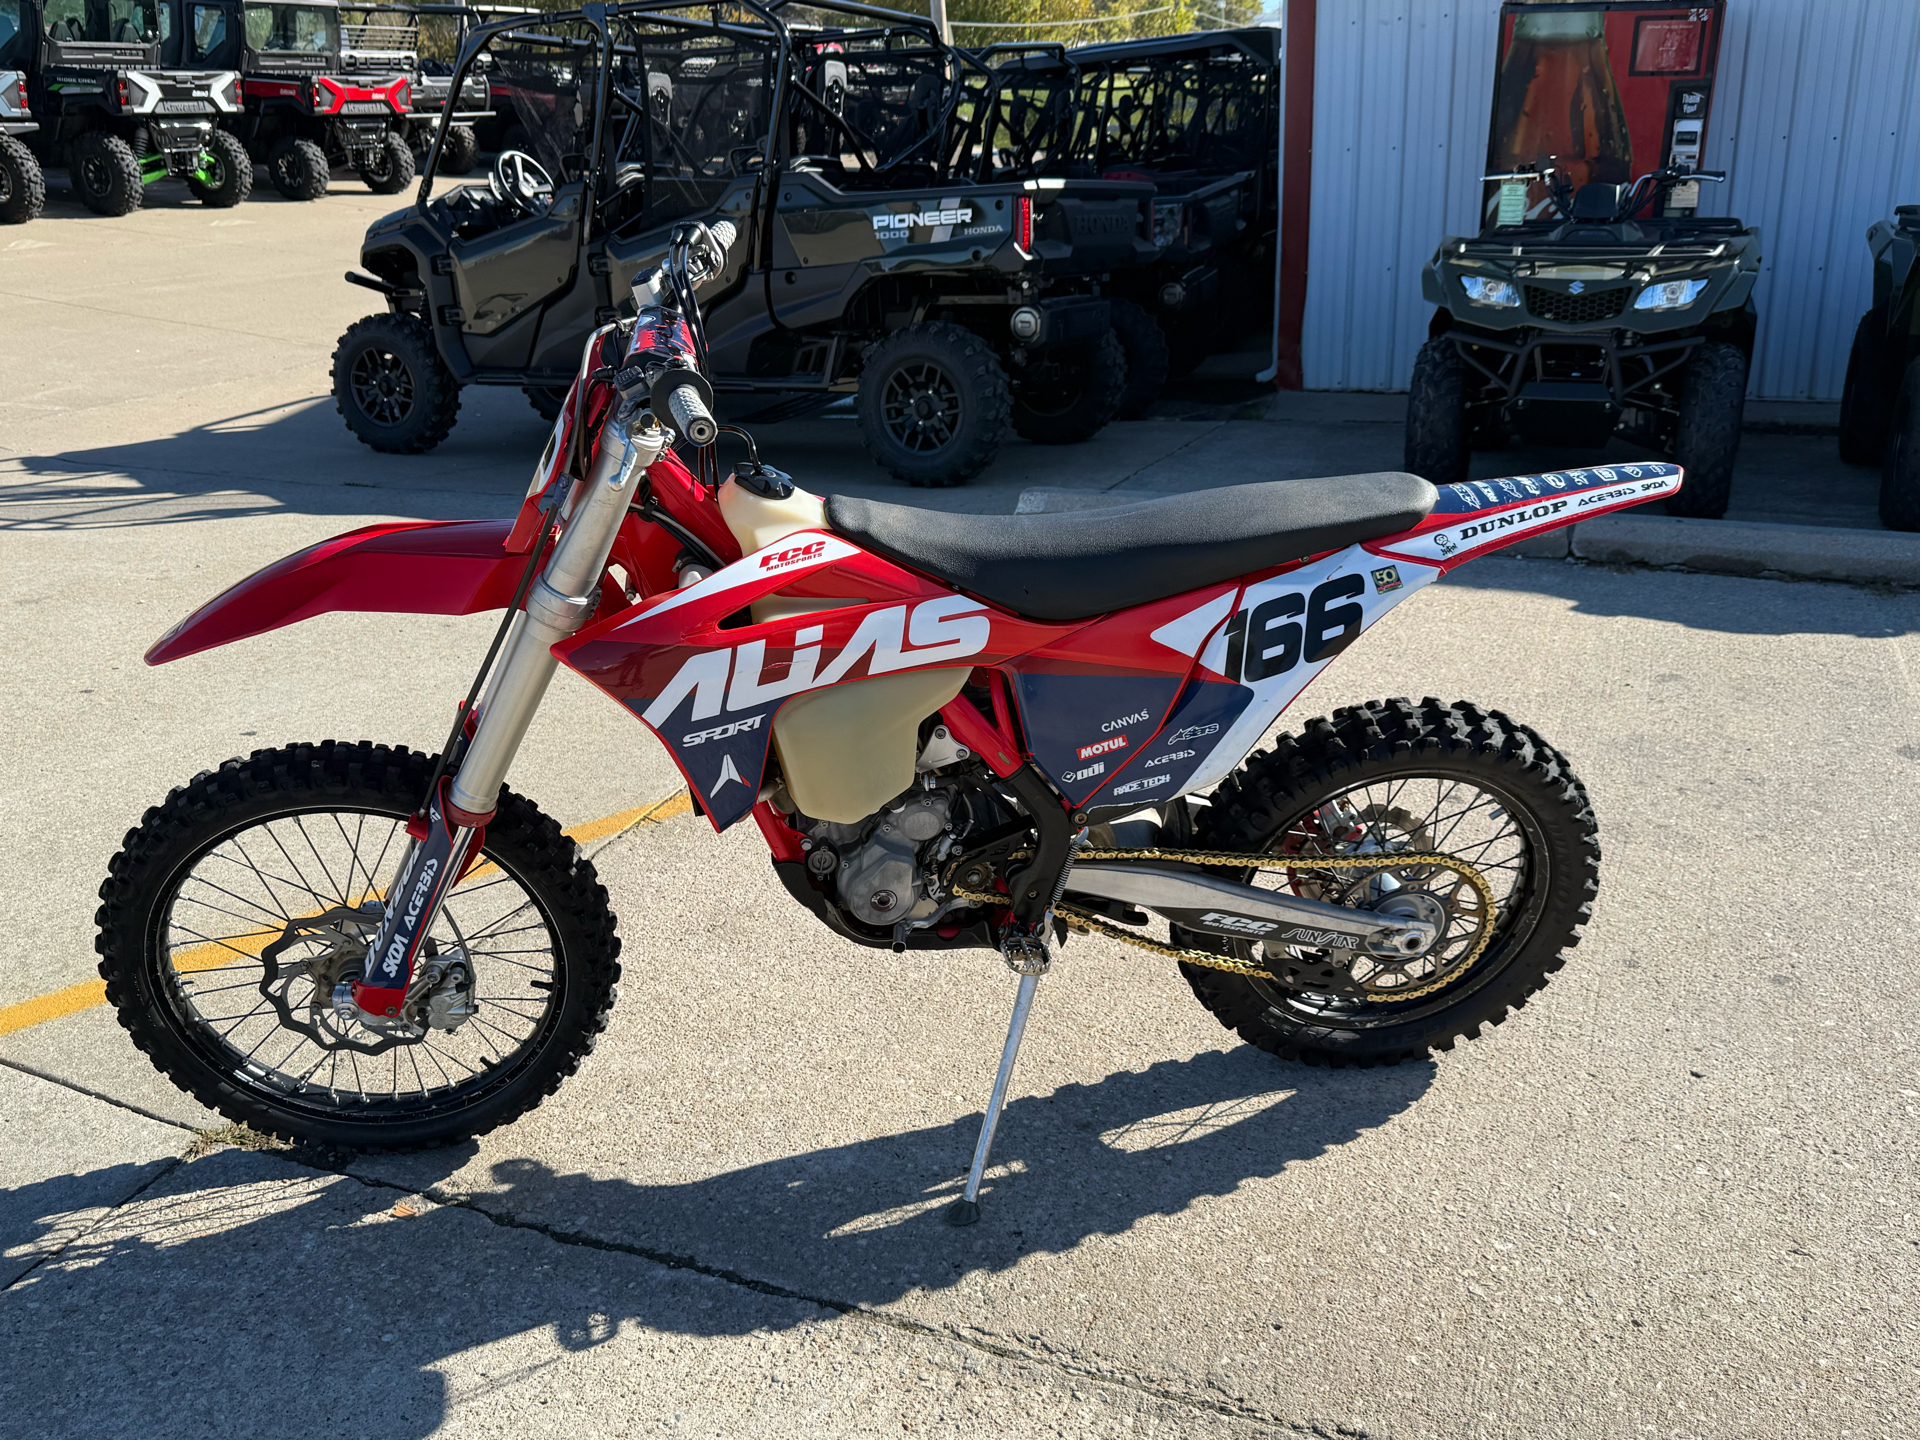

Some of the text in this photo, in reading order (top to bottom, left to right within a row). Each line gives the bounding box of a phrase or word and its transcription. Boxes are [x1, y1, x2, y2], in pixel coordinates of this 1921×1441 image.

[873, 208, 972, 230] PIONEER
[964, 224, 1003, 236] HONDA
[874, 230, 909, 240] 1000
[1459, 500, 1568, 541] DUNLOP
[759, 540, 826, 569] FCC
[765, 552, 823, 573] MOTOSPORTS
[1376, 567, 1397, 586] 50
[1223, 573, 1365, 684] 166
[682, 713, 767, 748] SPORT
[1101, 708, 1149, 733] CANVAS
[1080, 735, 1127, 759] MOTUL
[1113, 774, 1172, 797] RACE TECH
[1199, 912, 1279, 932] FCC
[1203, 920, 1266, 936] MOTOSPORTS
[1281, 928, 1360, 949] SUNSTAR
